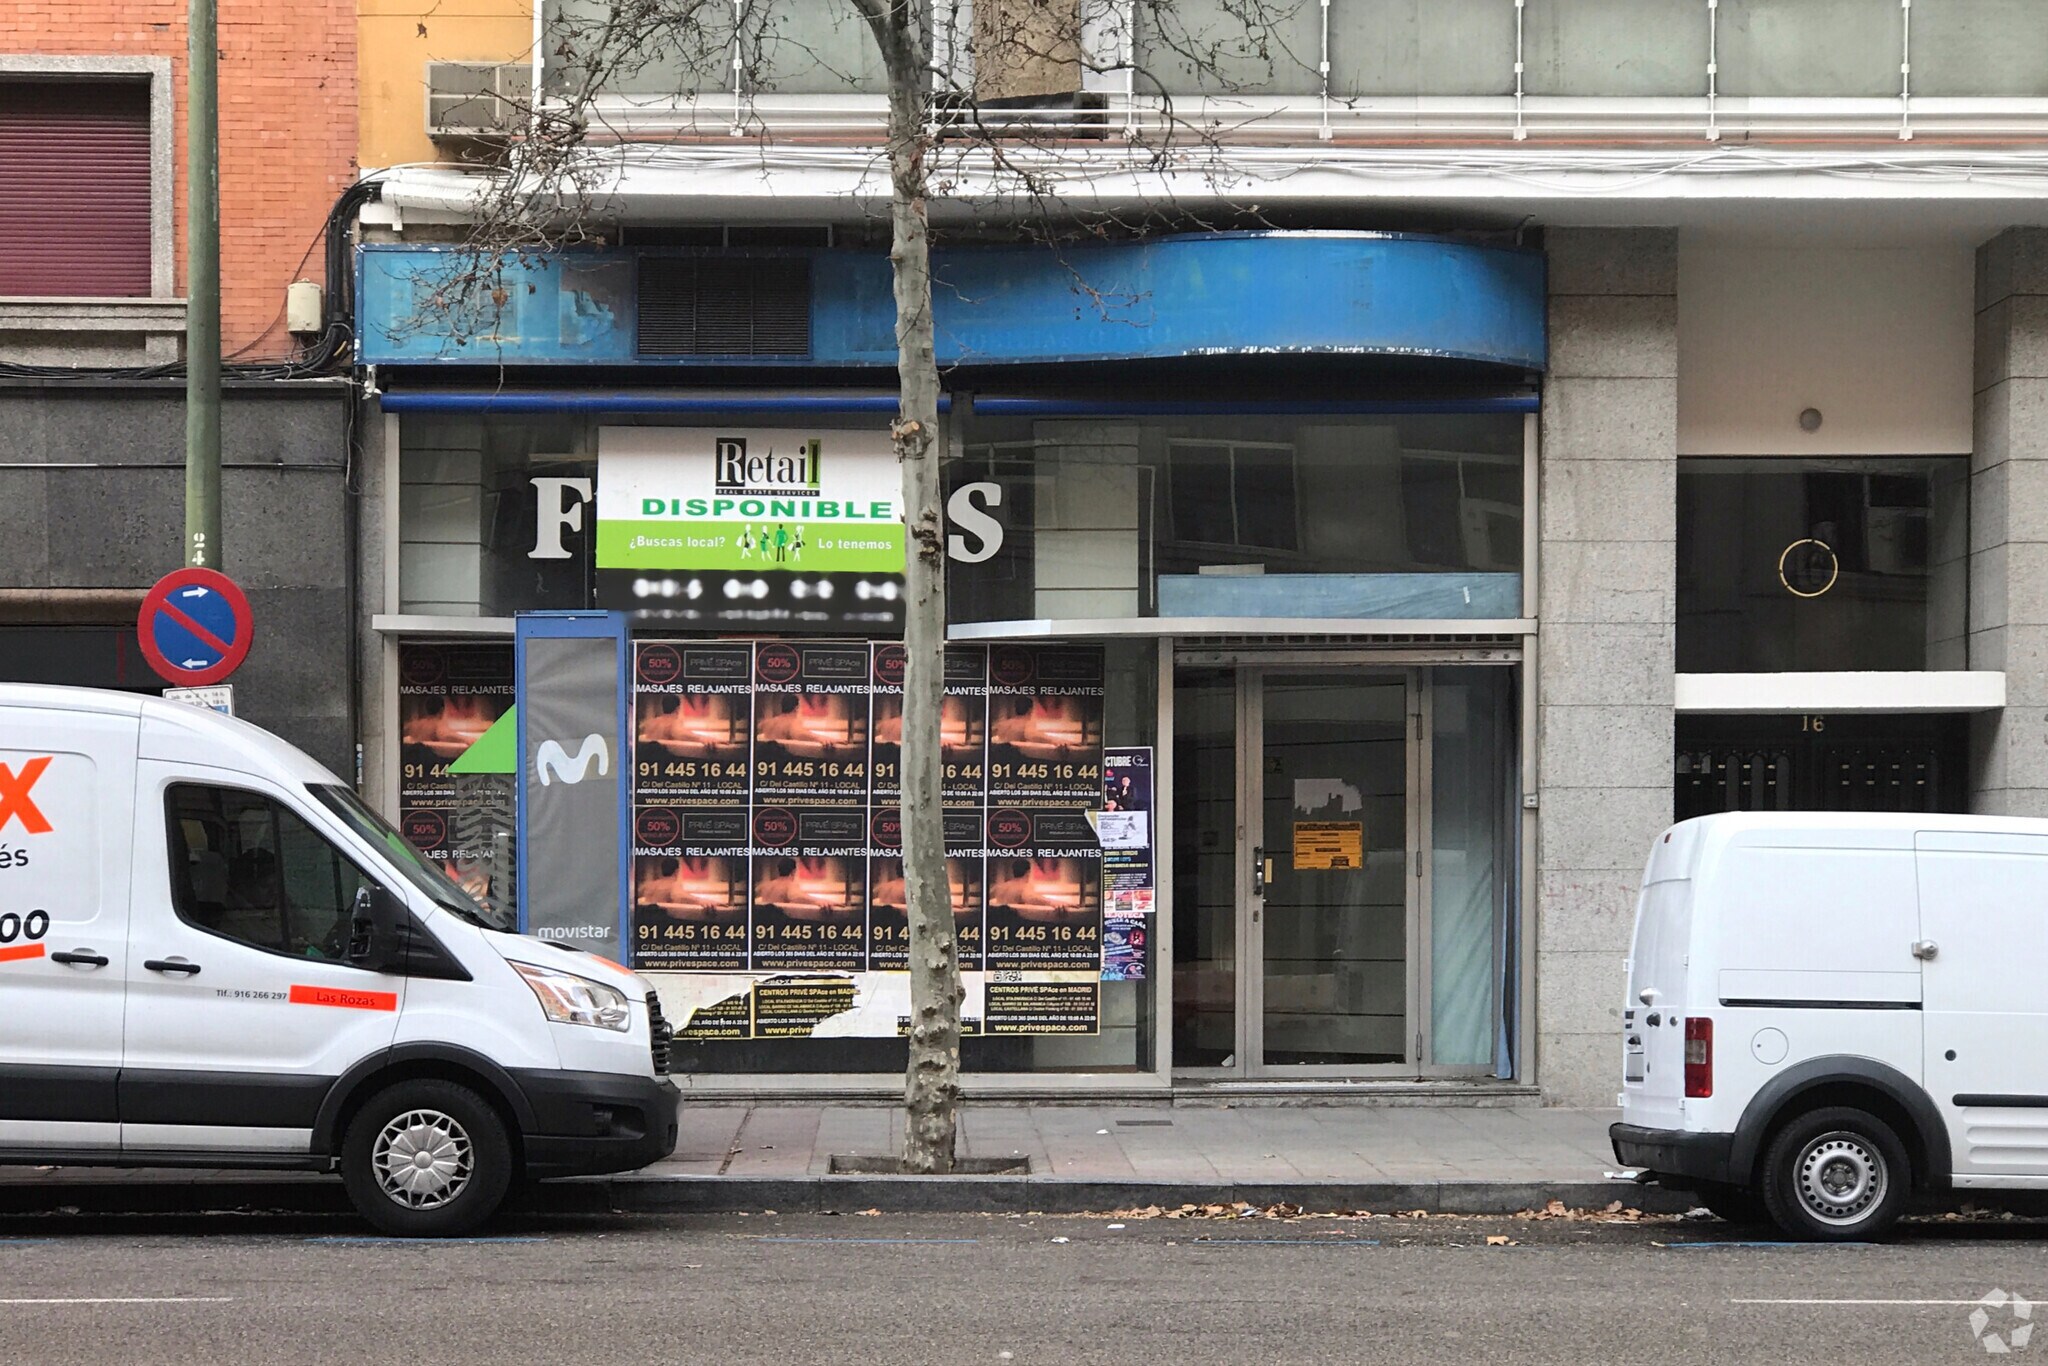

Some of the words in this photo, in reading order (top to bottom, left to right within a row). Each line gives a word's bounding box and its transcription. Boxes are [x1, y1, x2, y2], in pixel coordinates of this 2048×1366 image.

[716, 442, 820, 484] Retail
[642, 498, 893, 519] DISPONIBLE
[629, 535, 683, 549] ¿Buscas
[687, 536, 726, 548] local?
[818, 537, 834, 549] Lo
[838, 539, 892, 550] tenemos
[648, 658, 672, 668] 50%
[767, 658, 791, 668] 50%
[400, 685, 447, 695] MASAJES
[451, 685, 515, 695] RELAJANTES
[636, 684, 683, 693] MASAJES
[687, 684, 752, 694] RELAJANTES
[755, 683, 802, 693] MASAJES
[806, 684, 870, 694] RELAJANTES
[943, 686, 987, 696] AJANTES
[989, 685, 1036, 694] MASAJES
[1040, 686, 1104, 695] RELAJANTES
[1802, 715, 1824, 732] 16
[1104, 756, 1132, 767] CTUBRE
[405, 764, 424, 779] 91
[639, 762, 658, 777] 91
[665, 762, 695, 777] 445
[701, 763, 721, 777] 16
[726, 763, 746, 777] 44
[758, 762, 777, 776] 91
[783, 762, 813, 776] 445
[819, 763, 839, 777] 16
[844, 763, 864, 777] 44
[876, 763, 895, 778] 91
[961, 764, 981, 779] 44
[992, 764, 1011, 778] 91
[1017, 764, 1048, 778] 445
[1053, 765, 1073, 778] 16
[1078, 764, 1098, 779] 44
[645, 797, 739, 805] www.privespace.com
[763, 796, 857, 805] www.privespace.com
[998, 799, 1091, 807] www.privespace.com
[412, 823, 436, 834] 50%
[647, 822, 670, 832] 50%
[764, 822, 788, 832] 50%
[998, 823, 1022, 833] 50%
[635, 847, 682, 856] MASAJES
[686, 847, 749, 857] RELAJANTES
[752, 847, 799, 856] MASAJES
[803, 847, 867, 857] RELAJANTES
[987, 848, 1033, 858] MASAJES
[1037, 848, 1101, 858] RELAJANTES
[538, 926, 611, 939] movistar
[639, 925, 658, 940] 91
[664, 925, 694, 939] 445
[700, 925, 720, 939] 16
[724, 925, 744, 939] 44
[756, 925, 775, 939] 91
[781, 925, 811, 939] 445
[817, 925, 837, 939] 16
[842, 925, 862, 939] 44
[874, 926, 892, 941] 91
[959, 926, 979, 941] 44
[991, 927, 1010, 941] 91
[1016, 926, 1046, 941] 445
[1051, 926, 1071, 940] 16
[1076, 926, 1096, 940] 44
[645, 959, 738, 968] www.privespace.com
[762, 959, 856, 967] www.privespace.com
[997, 960, 1090, 969] www.privespace.com
[235, 990, 250, 998] 916
[253, 991, 269, 999] 266
[271, 992, 287, 1000] 297
[316, 992, 336, 1003] Las
[340, 994, 375, 1006] Rozas
[995, 1023, 1087, 1032] www.privespace.com
